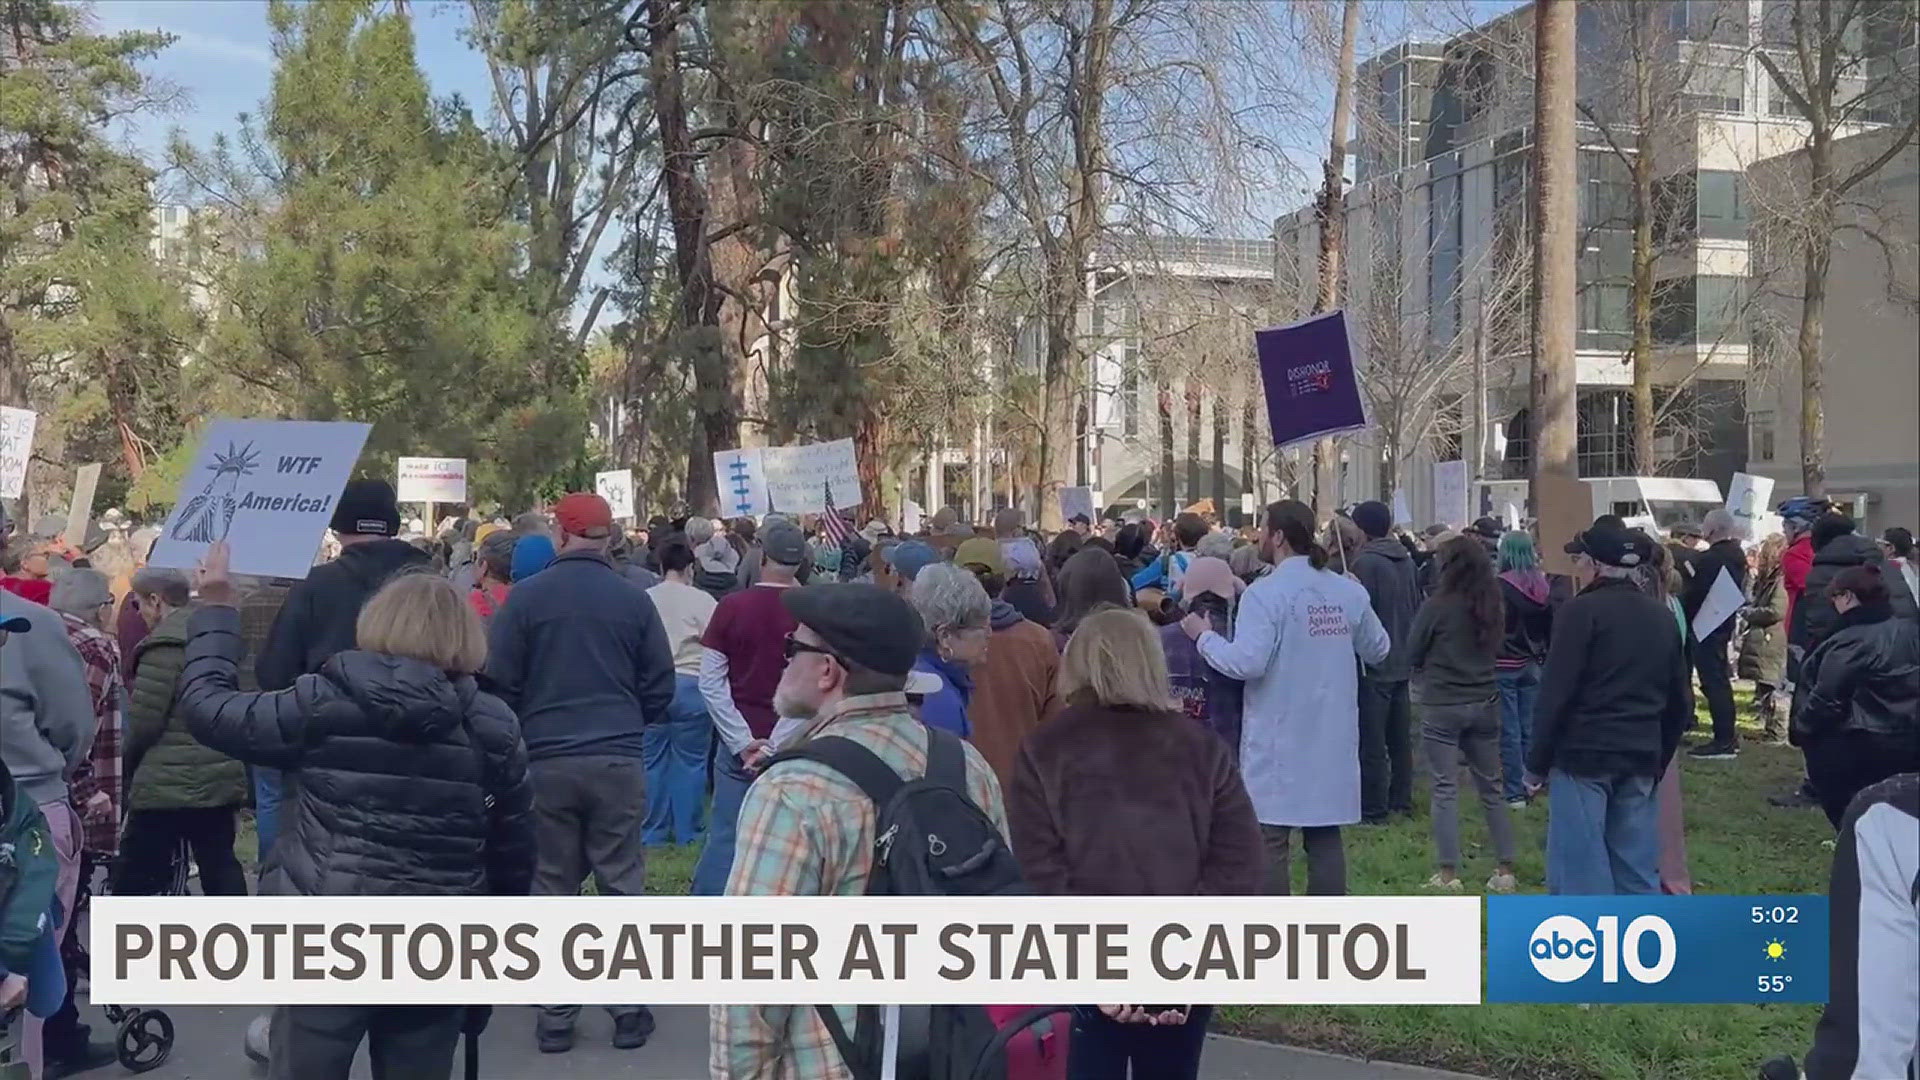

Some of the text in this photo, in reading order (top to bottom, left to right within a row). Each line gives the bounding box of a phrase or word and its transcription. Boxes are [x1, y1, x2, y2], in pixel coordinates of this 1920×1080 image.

[277, 456, 322, 474] WTF
[238, 491, 332, 513] America!
[1307, 604, 1343, 615] Doctors
[1308, 616, 1342, 627] Against
[1309, 625, 1350, 637] Genocid
